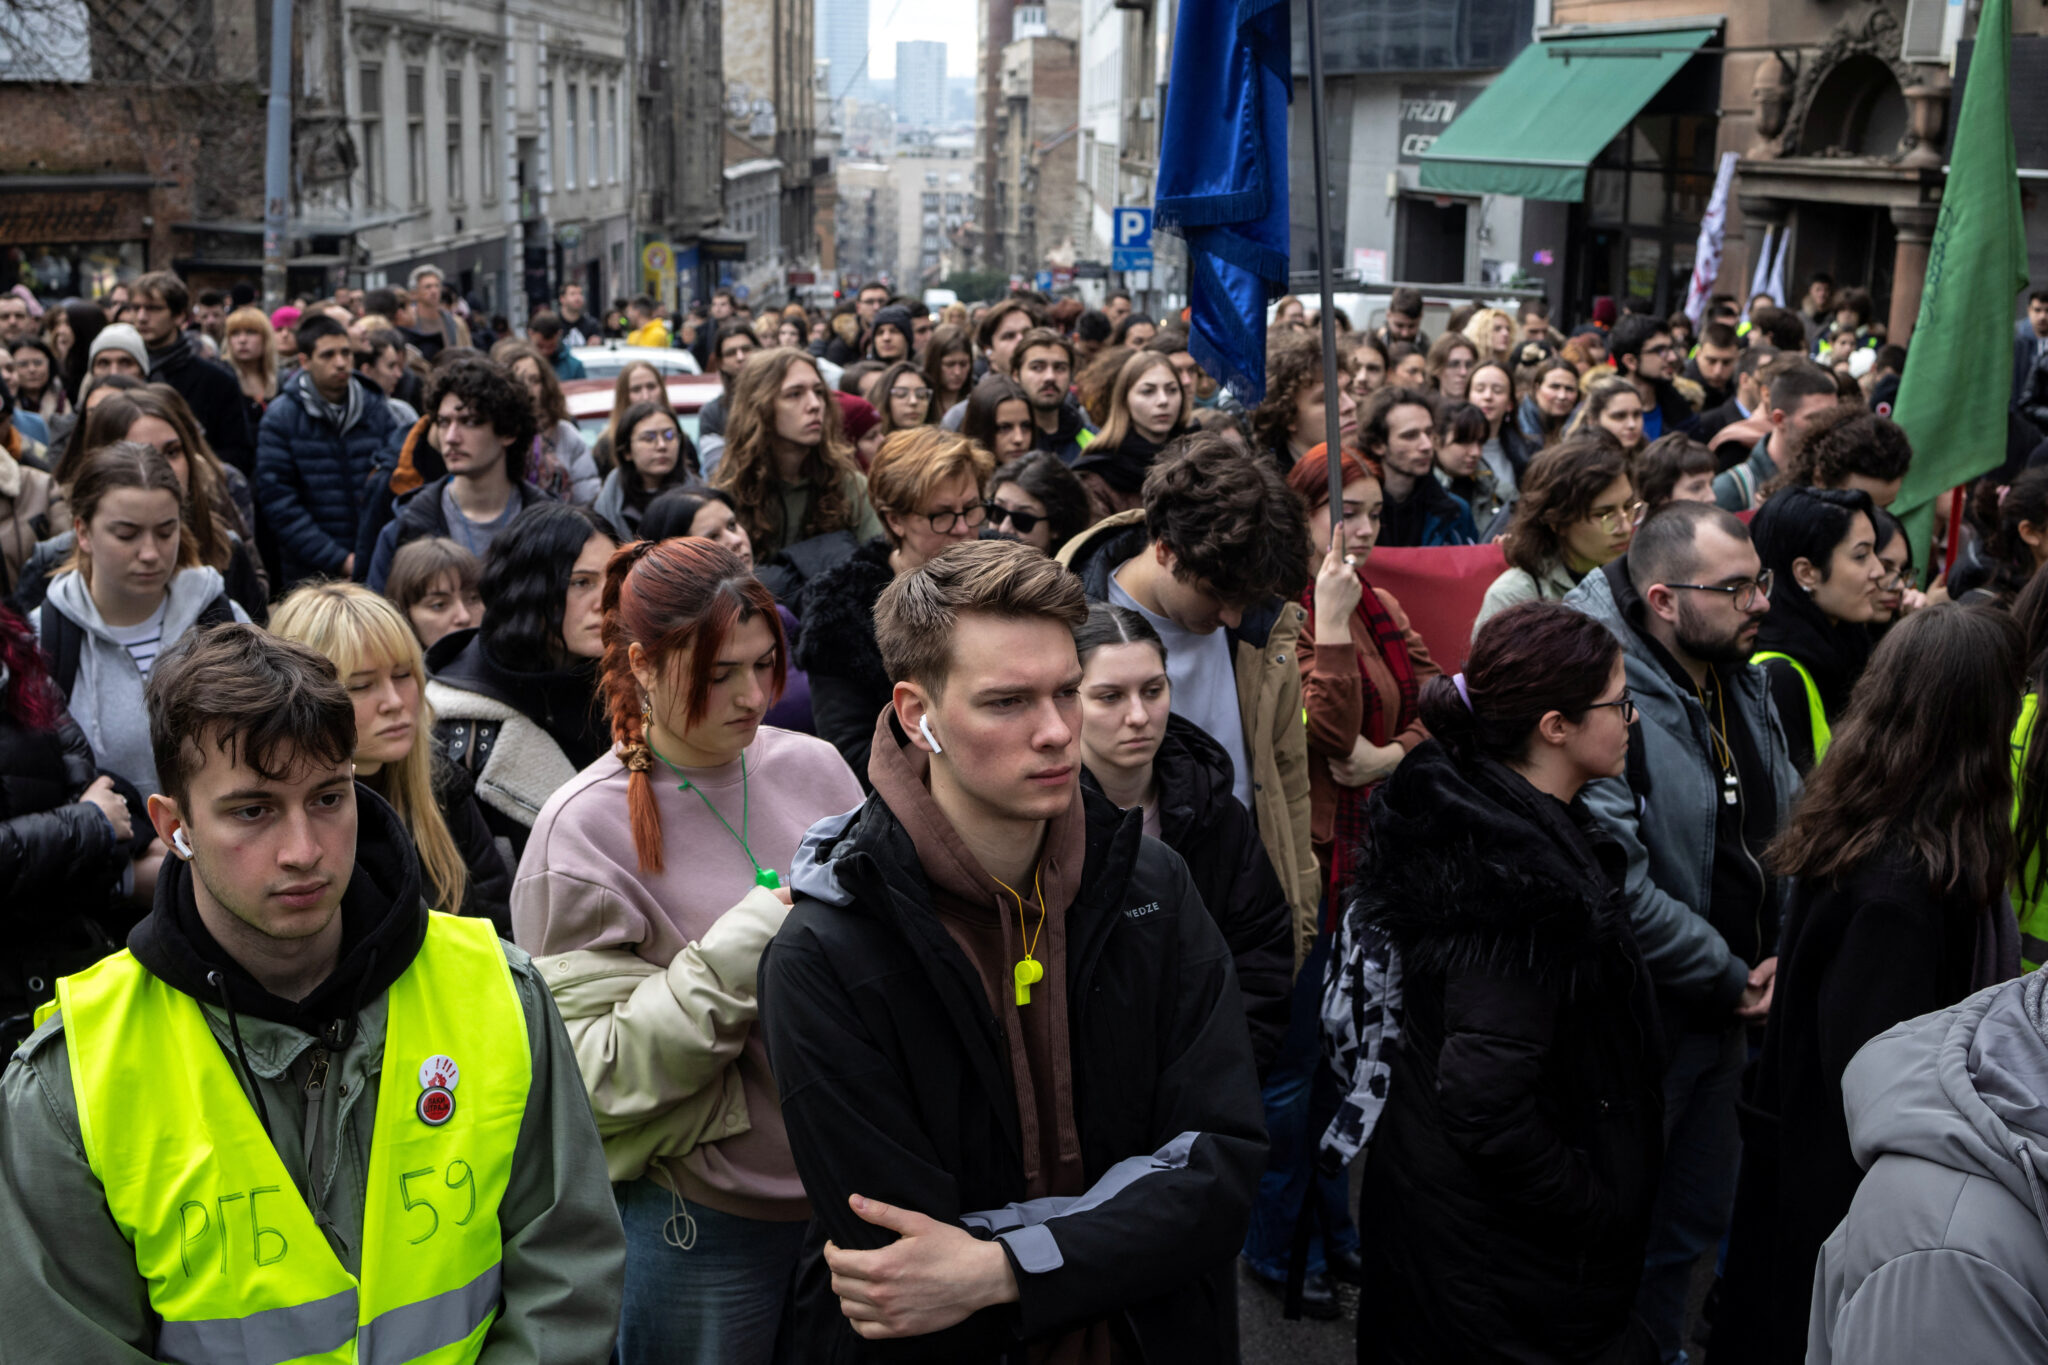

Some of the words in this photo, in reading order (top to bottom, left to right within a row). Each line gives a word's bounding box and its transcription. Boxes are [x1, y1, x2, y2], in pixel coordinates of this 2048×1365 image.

[1121, 210, 1146, 246] P
[1123, 901, 1160, 918] WEDZE
[178, 1184, 288, 1278] РГБ
[399, 1159, 477, 1245] 59
